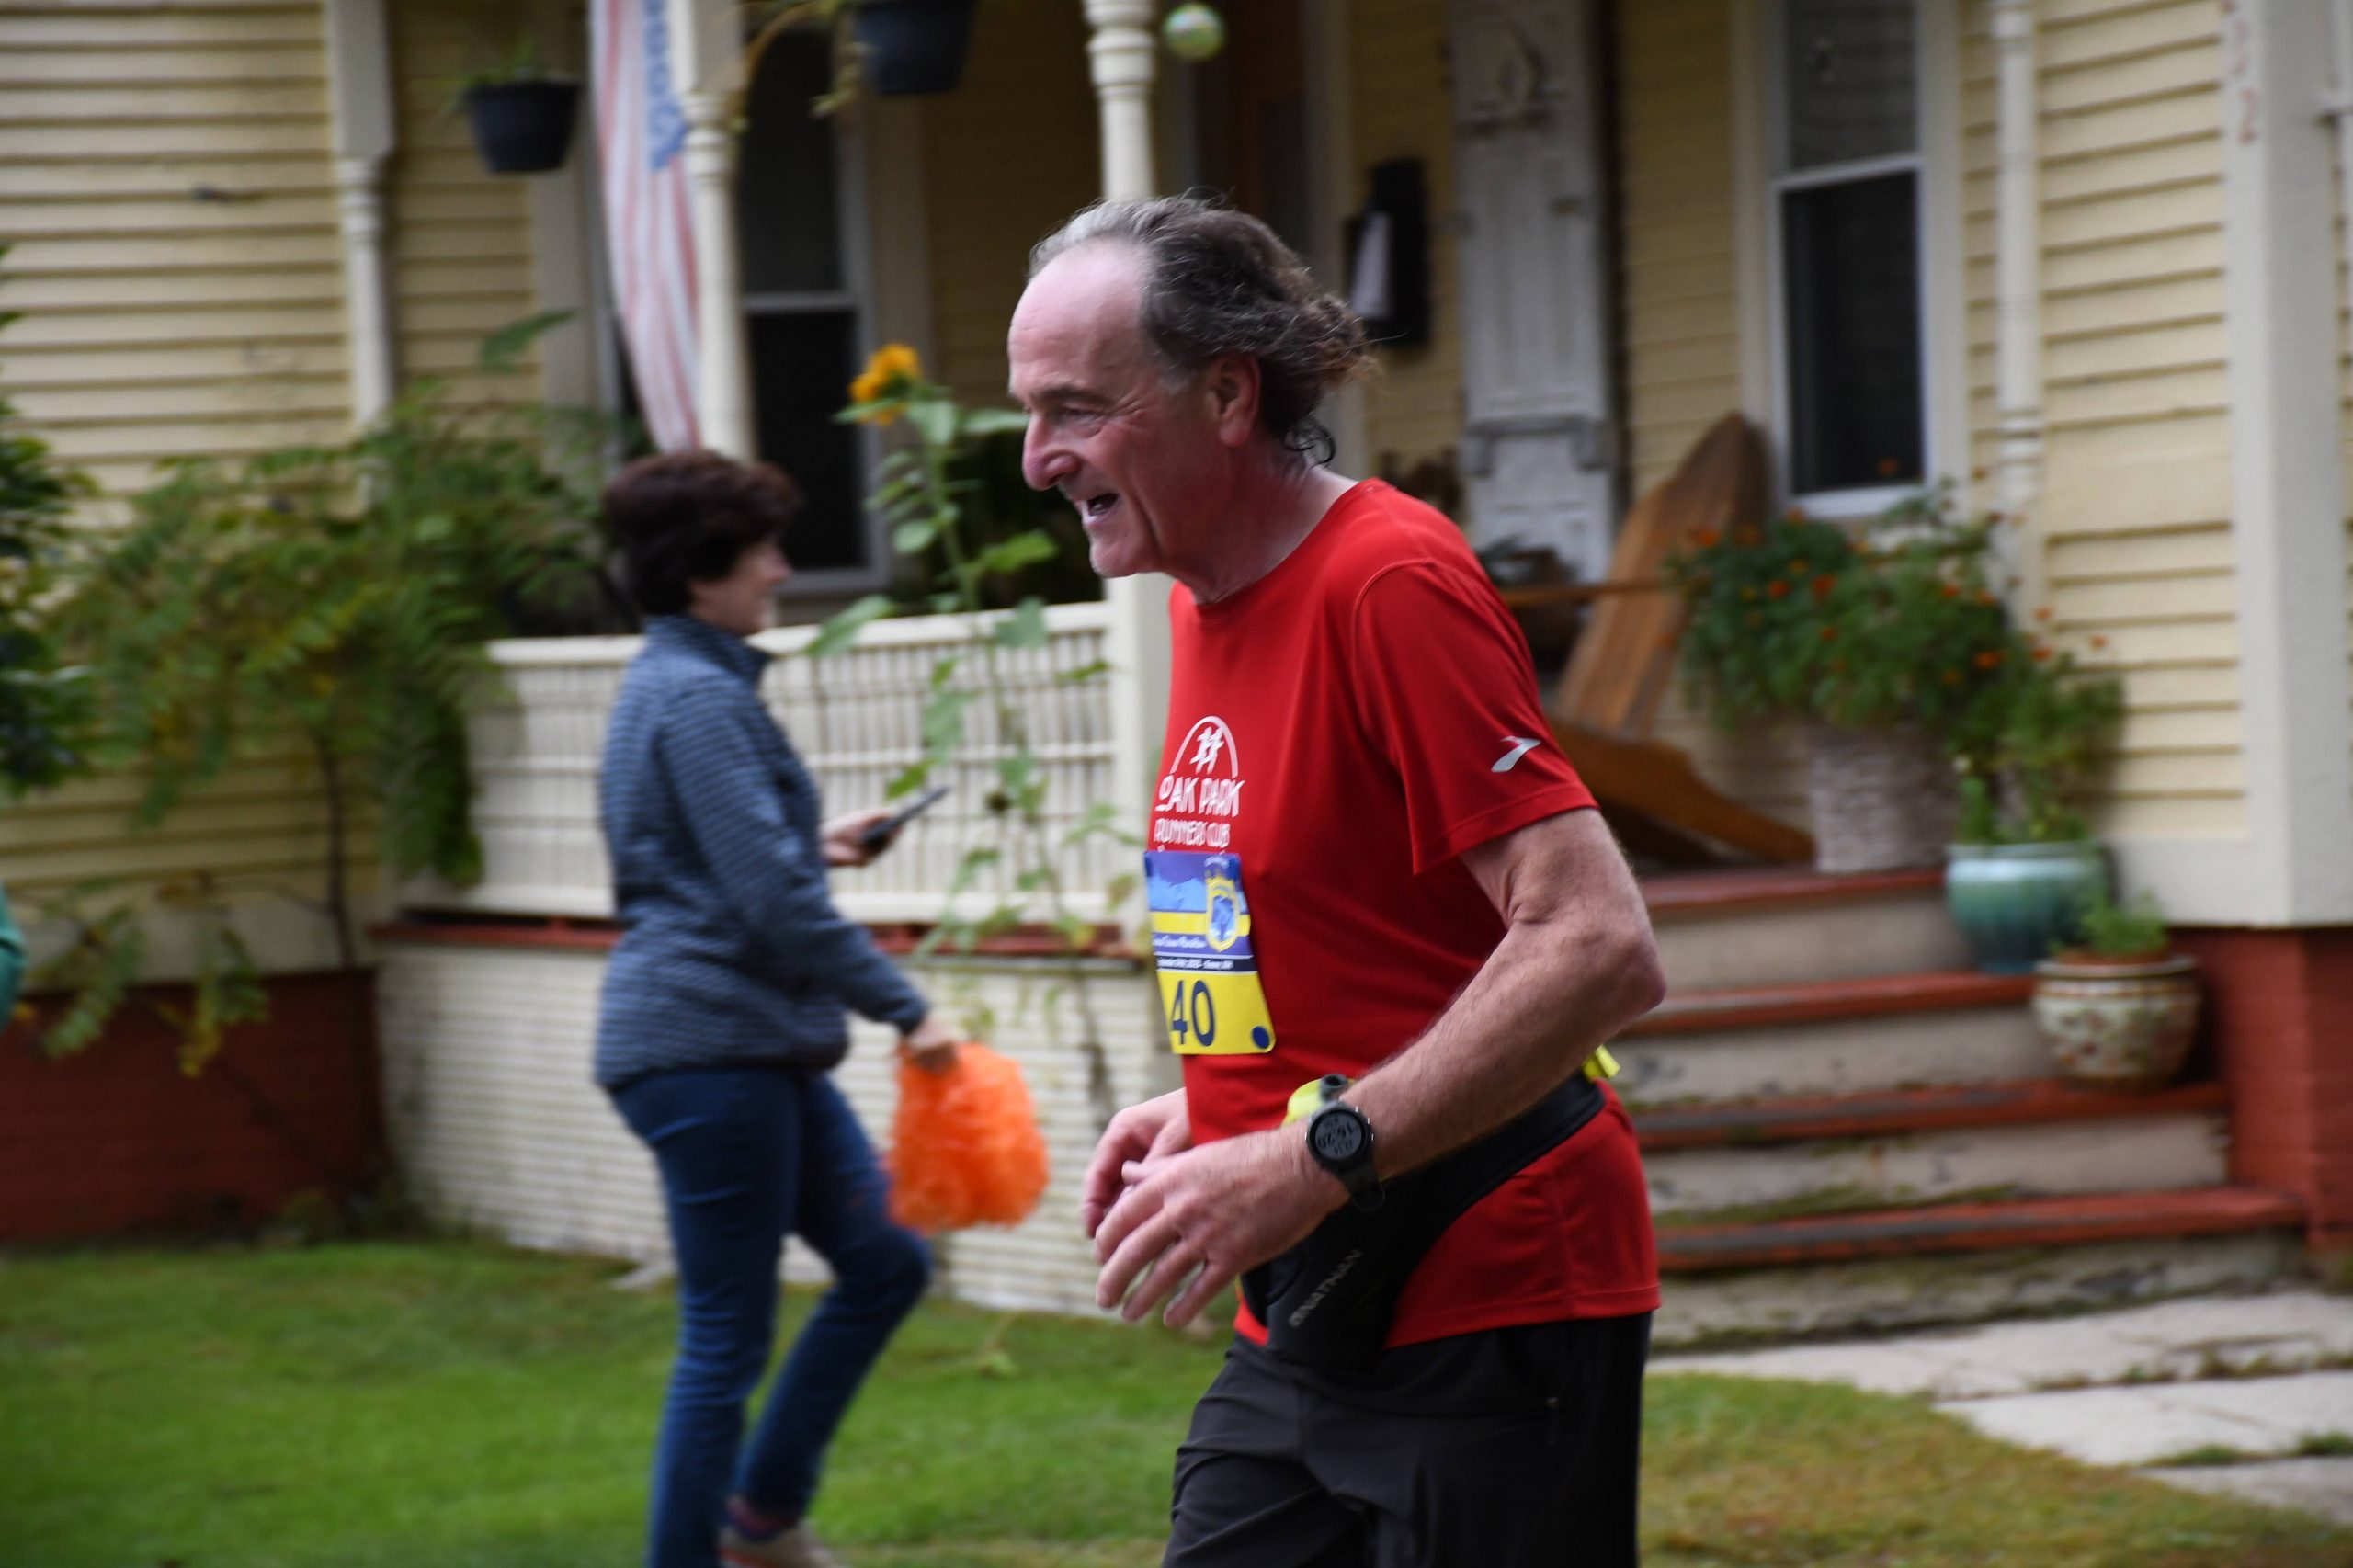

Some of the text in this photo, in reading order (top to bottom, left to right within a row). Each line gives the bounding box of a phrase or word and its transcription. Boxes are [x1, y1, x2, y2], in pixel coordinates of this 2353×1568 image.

[1154, 774, 1245, 817] OAK PARK
[1169, 979, 1215, 1046] 40
